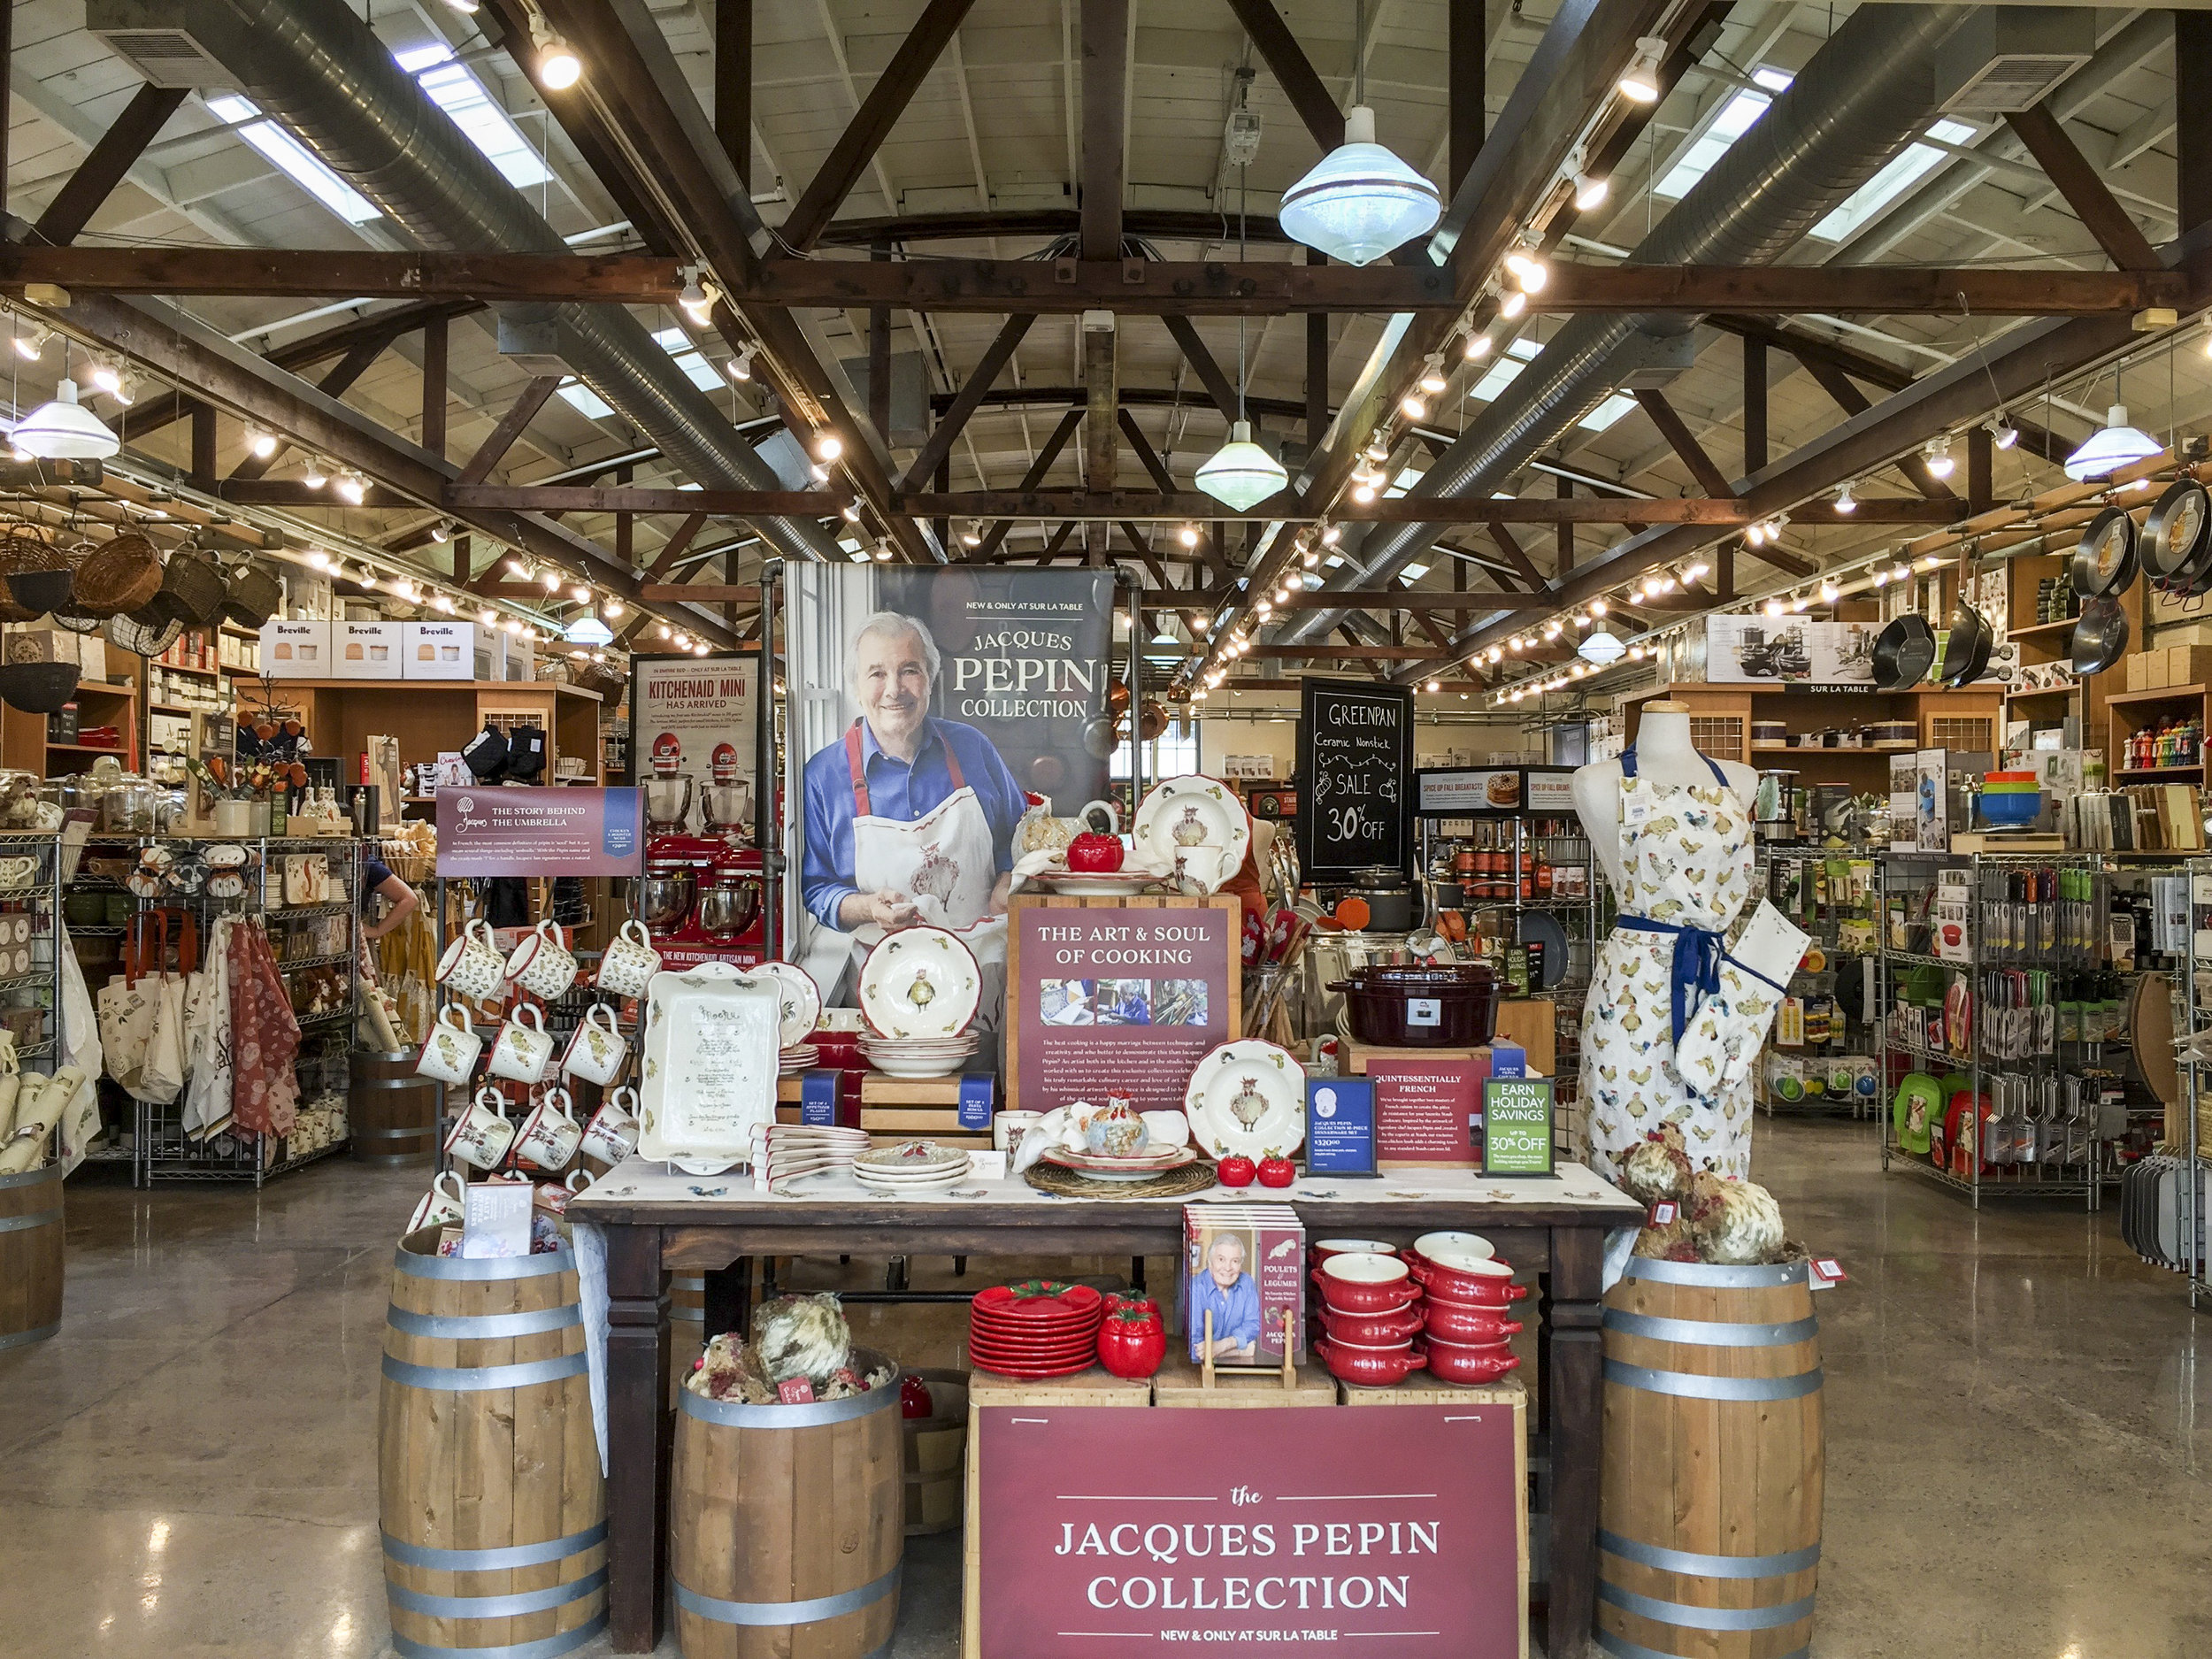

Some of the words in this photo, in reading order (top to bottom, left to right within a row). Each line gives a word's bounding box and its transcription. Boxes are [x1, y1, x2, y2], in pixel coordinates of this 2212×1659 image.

[277, 626, 311, 635] Breville
[349, 626, 382, 635] Breville
[420, 626, 453, 635] Breville
[974, 631, 1072, 651] JACQUES
[954, 658, 1097, 693] PEPIN
[649, 680, 715, 699] KITCHENAID
[720, 680, 745, 697] MINI
[961, 699, 1087, 717] COLLECTION
[1329, 704, 1396, 727] GREENPAN
[1315, 732, 1350, 747] Ceramic
[1356, 736, 1391, 749] Nonstick
[1336, 773, 1371, 795] SALE
[1327, 804, 1366, 841] 30%
[1362, 821, 1385, 840] OFF
[1038, 927, 1082, 941] THE
[1088, 927, 1131, 941] ART
[1136, 927, 1148, 941] &
[1154, 927, 1210, 941] SOUL
[663, 950, 672, 960] THE
[673, 952, 685, 961] NEW
[719, 954, 741, 964] ARTISAN
[743, 955, 756, 964] MINI
[1056, 949, 1085, 964] OF
[1091, 949, 1193, 964] COOKING
[1502, 1085, 1534, 1095] EARN
[1491, 1097, 1545, 1108] HOLIDAY
[1492, 1110, 1545, 1121] SAVINGS
[1490, 1137, 1517, 1150] 30%
[1517, 1138, 1547, 1150] OFF
[1230, 1485, 1263, 1507] the
[1054, 1522, 1276, 1564] JACQUES
[1293, 1521, 1440, 1555] PEPIN
[1087, 1576, 1410, 1609] COLLECTION
[1161, 1630, 1189, 1641] NEW
[1191, 1630, 1202, 1641] &
[1203, 1630, 1236, 1641] ONLY
[1239, 1630, 1253, 1641] AT
[1256, 1630, 1280, 1641] SUR
[1284, 1630, 1299, 1641] LA
[1301, 1630, 1338, 1641] TABLE
